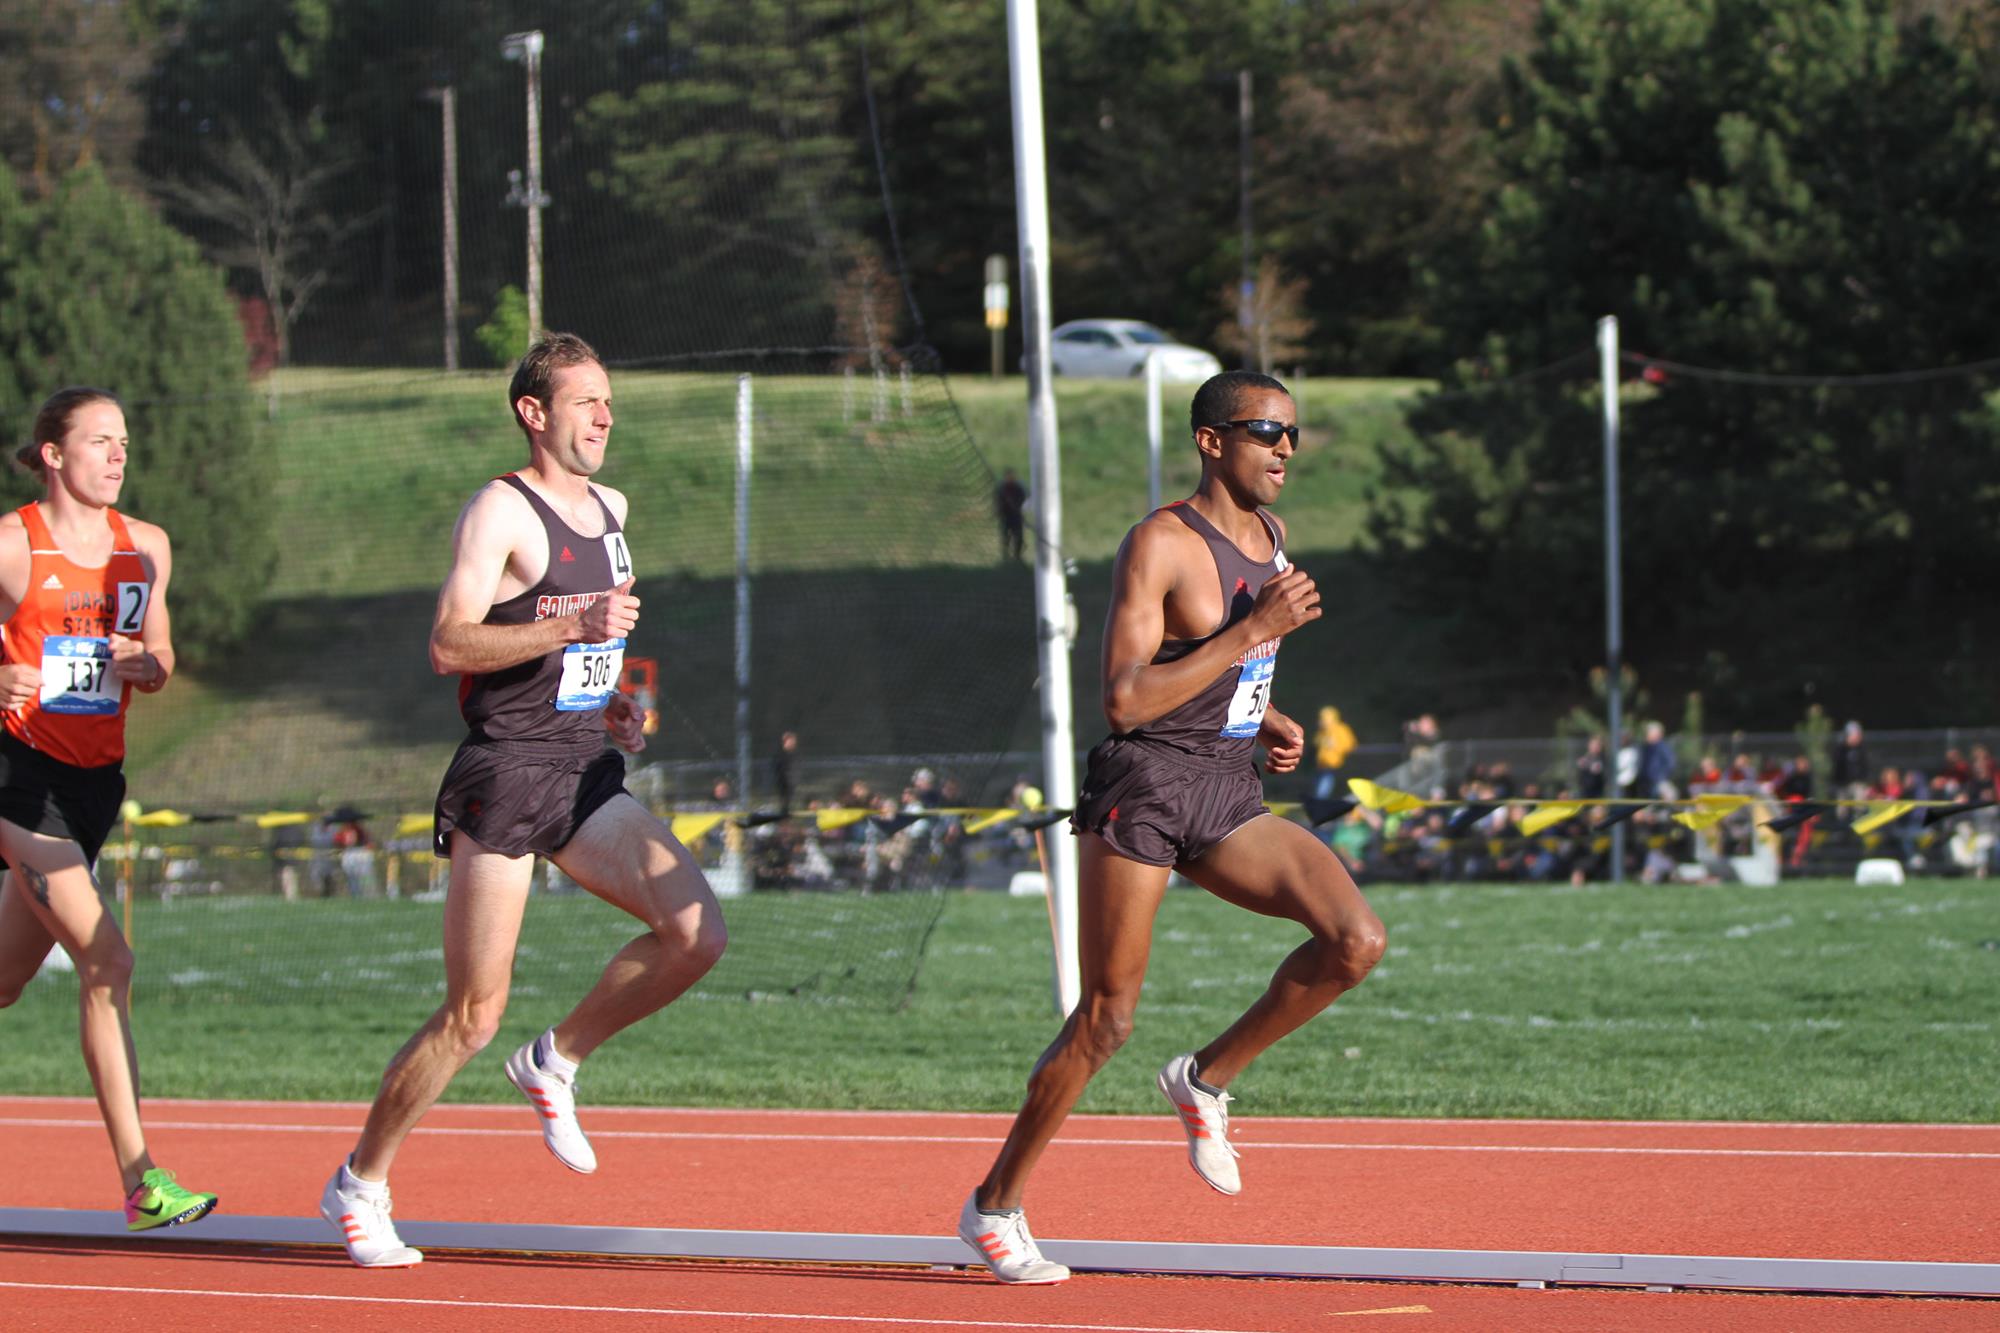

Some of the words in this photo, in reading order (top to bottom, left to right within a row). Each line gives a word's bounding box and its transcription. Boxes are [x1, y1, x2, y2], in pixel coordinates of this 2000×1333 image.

[615, 537, 629, 580] 4
[64, 592, 115, 614] IDAHO
[122, 585, 142, 630] 2
[63, 617, 112, 637] STATE
[66, 661, 106, 692] 137
[581, 654, 611, 687] 506
